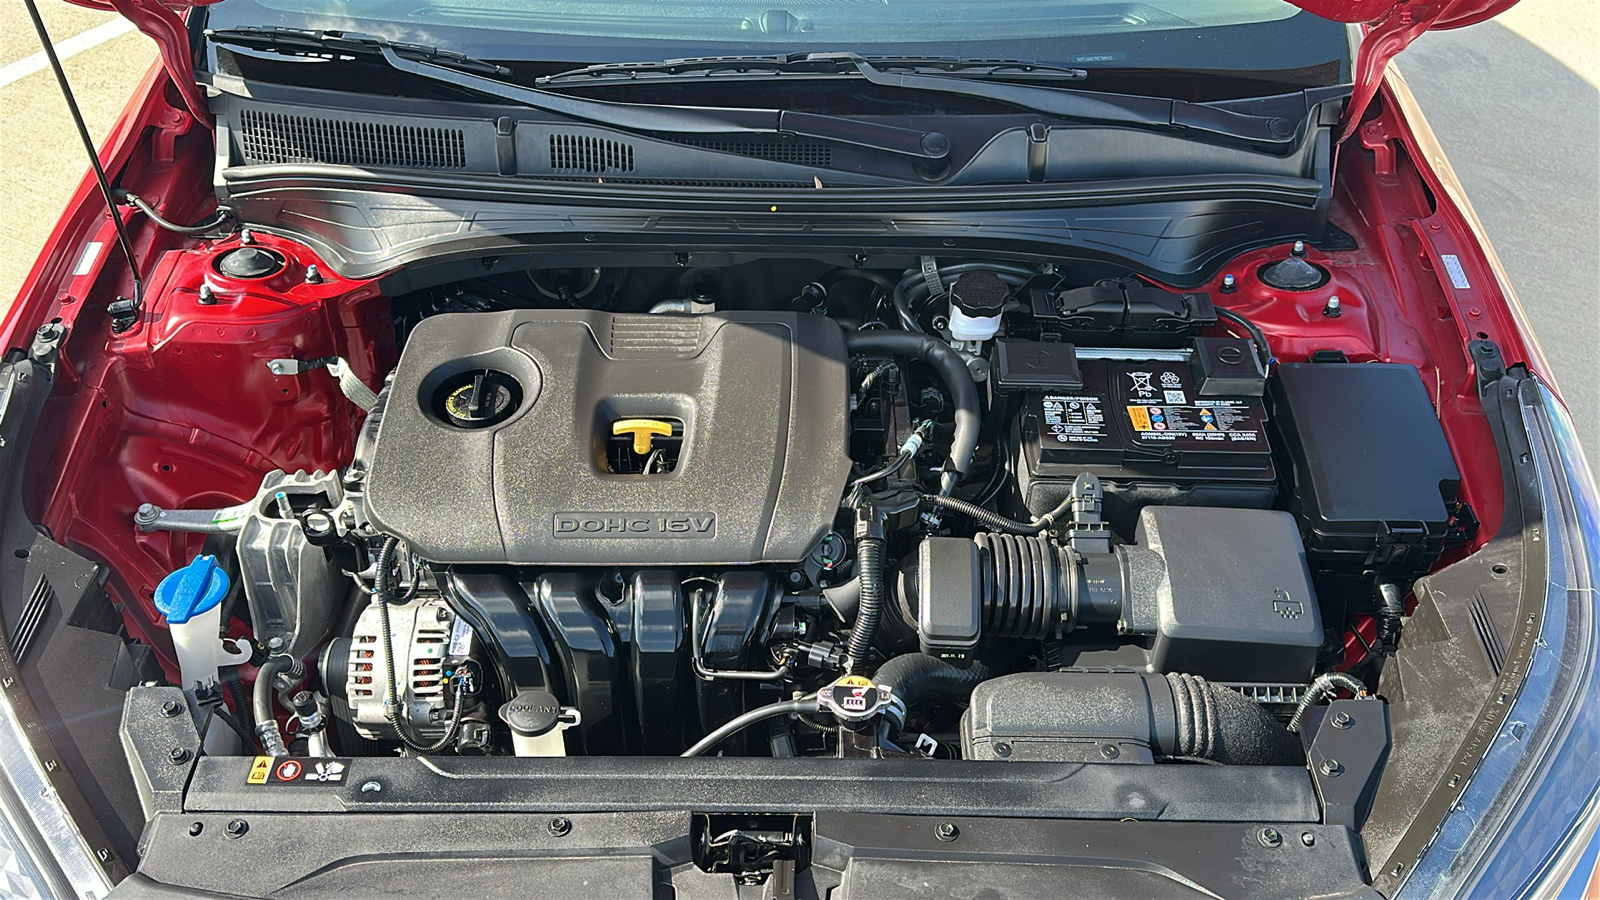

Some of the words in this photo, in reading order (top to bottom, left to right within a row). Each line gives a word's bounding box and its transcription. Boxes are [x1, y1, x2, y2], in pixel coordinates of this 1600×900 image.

[556, 518, 650, 532] DOHC
[658, 518, 714, 532] 16V
[509, 705, 557, 714] COOLANT
